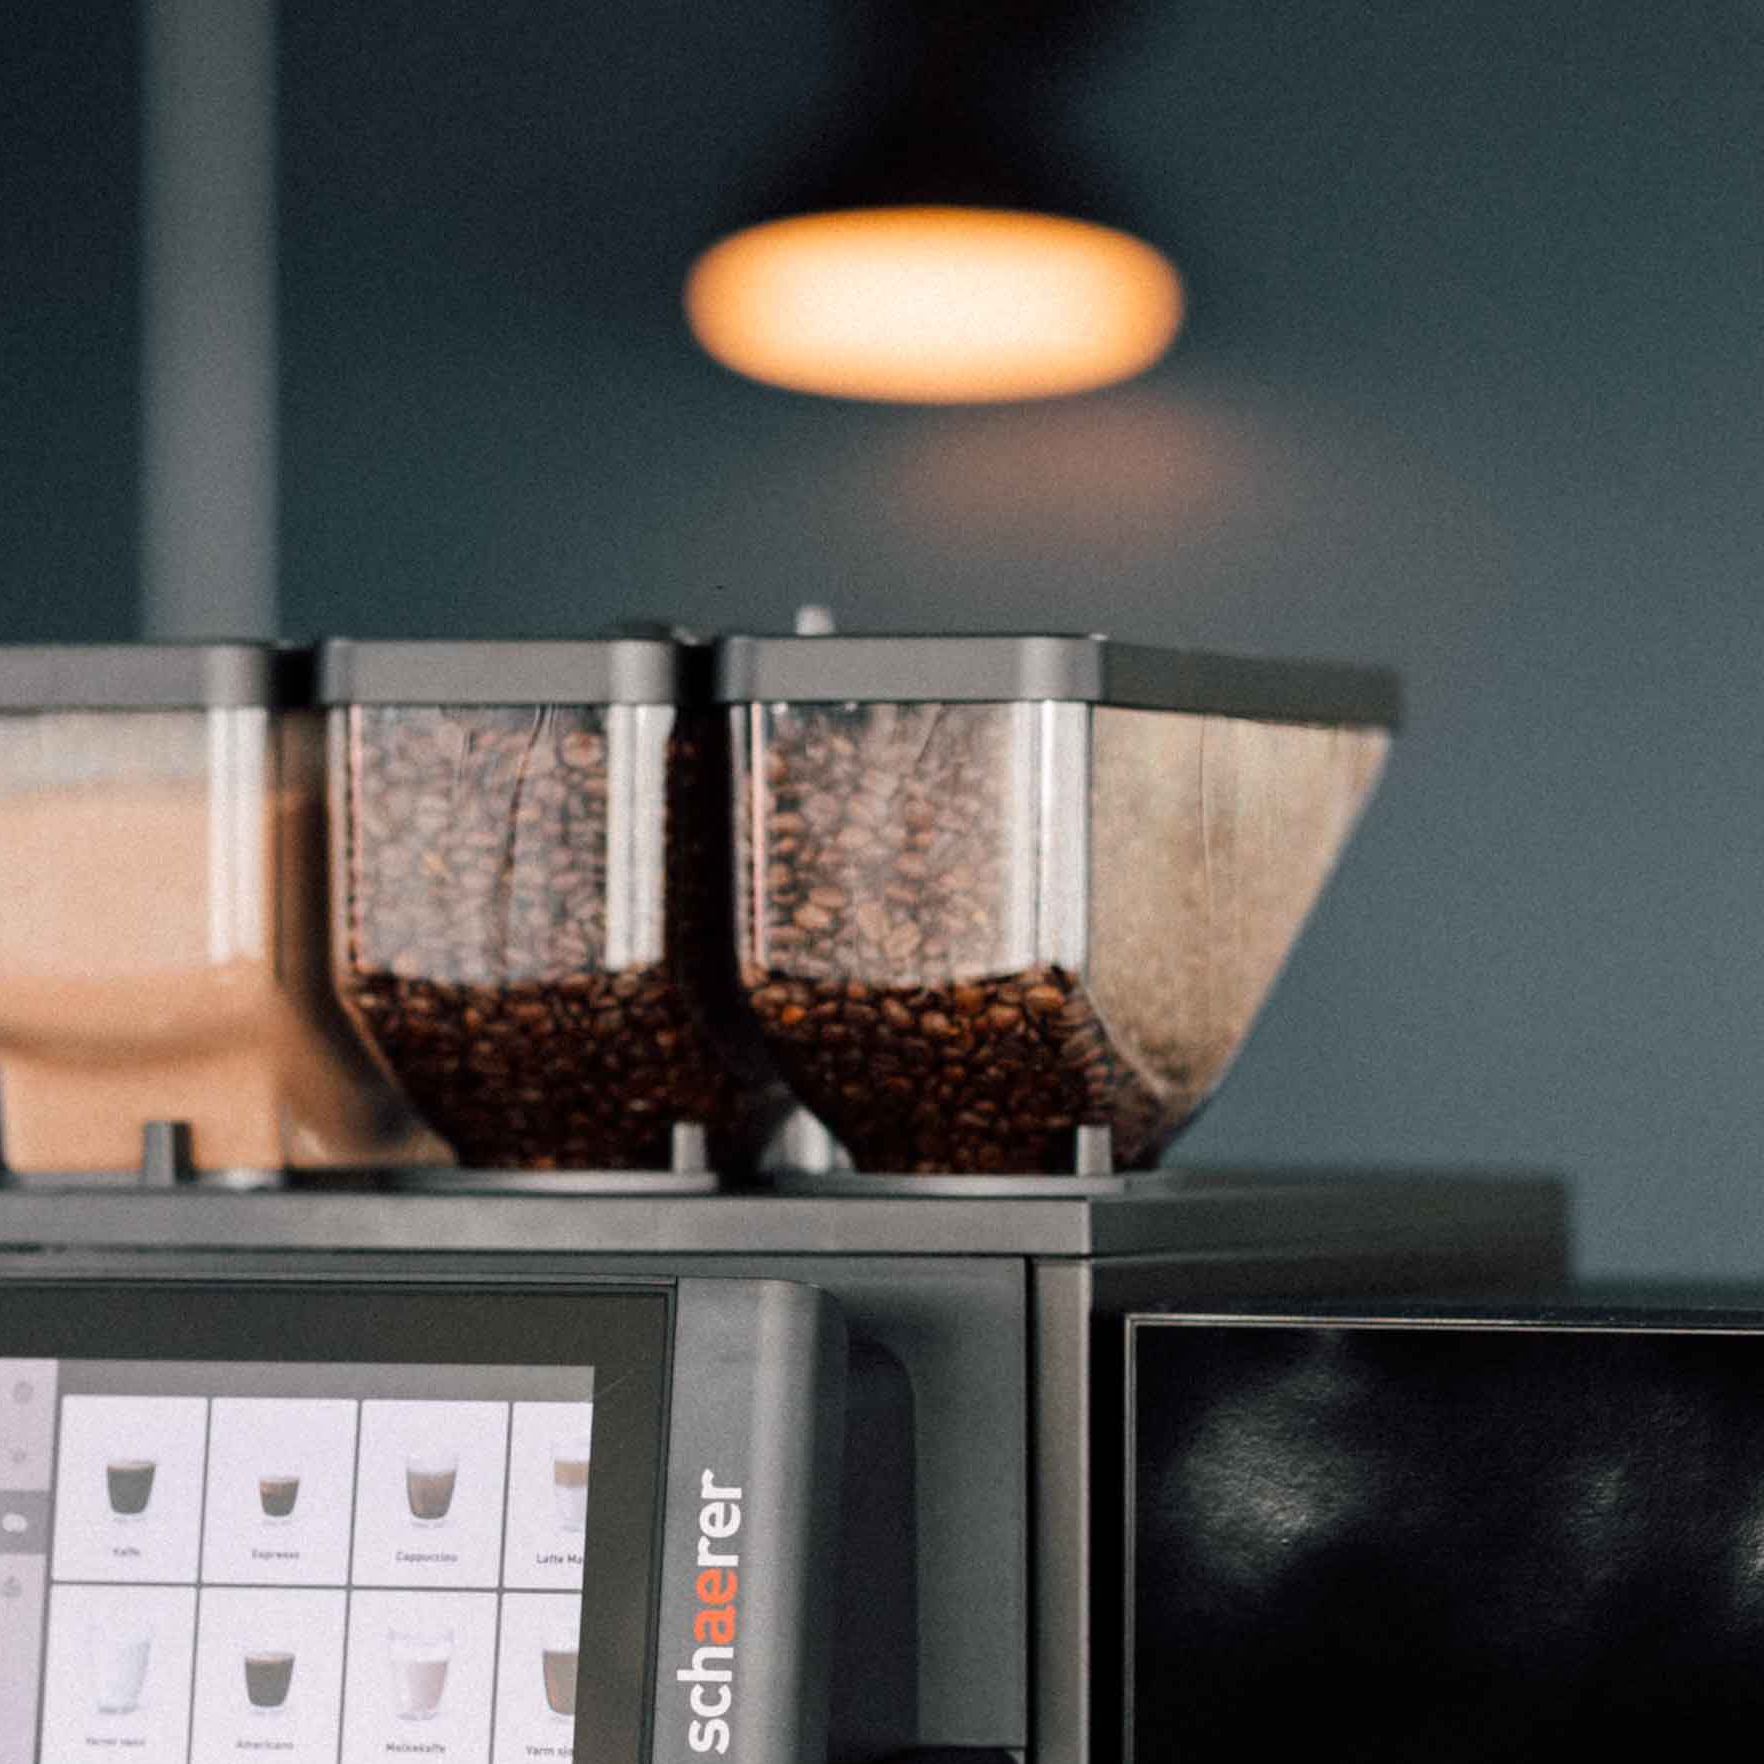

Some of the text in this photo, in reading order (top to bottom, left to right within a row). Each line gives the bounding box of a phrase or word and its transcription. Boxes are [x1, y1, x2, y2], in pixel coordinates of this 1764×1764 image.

[251, 1548, 300, 1560] Espresso
[395, 1551, 458, 1563] Cappuccino
[536, 1553, 564, 1564] Latte
[676, 1468, 743, 1754] schaerer
